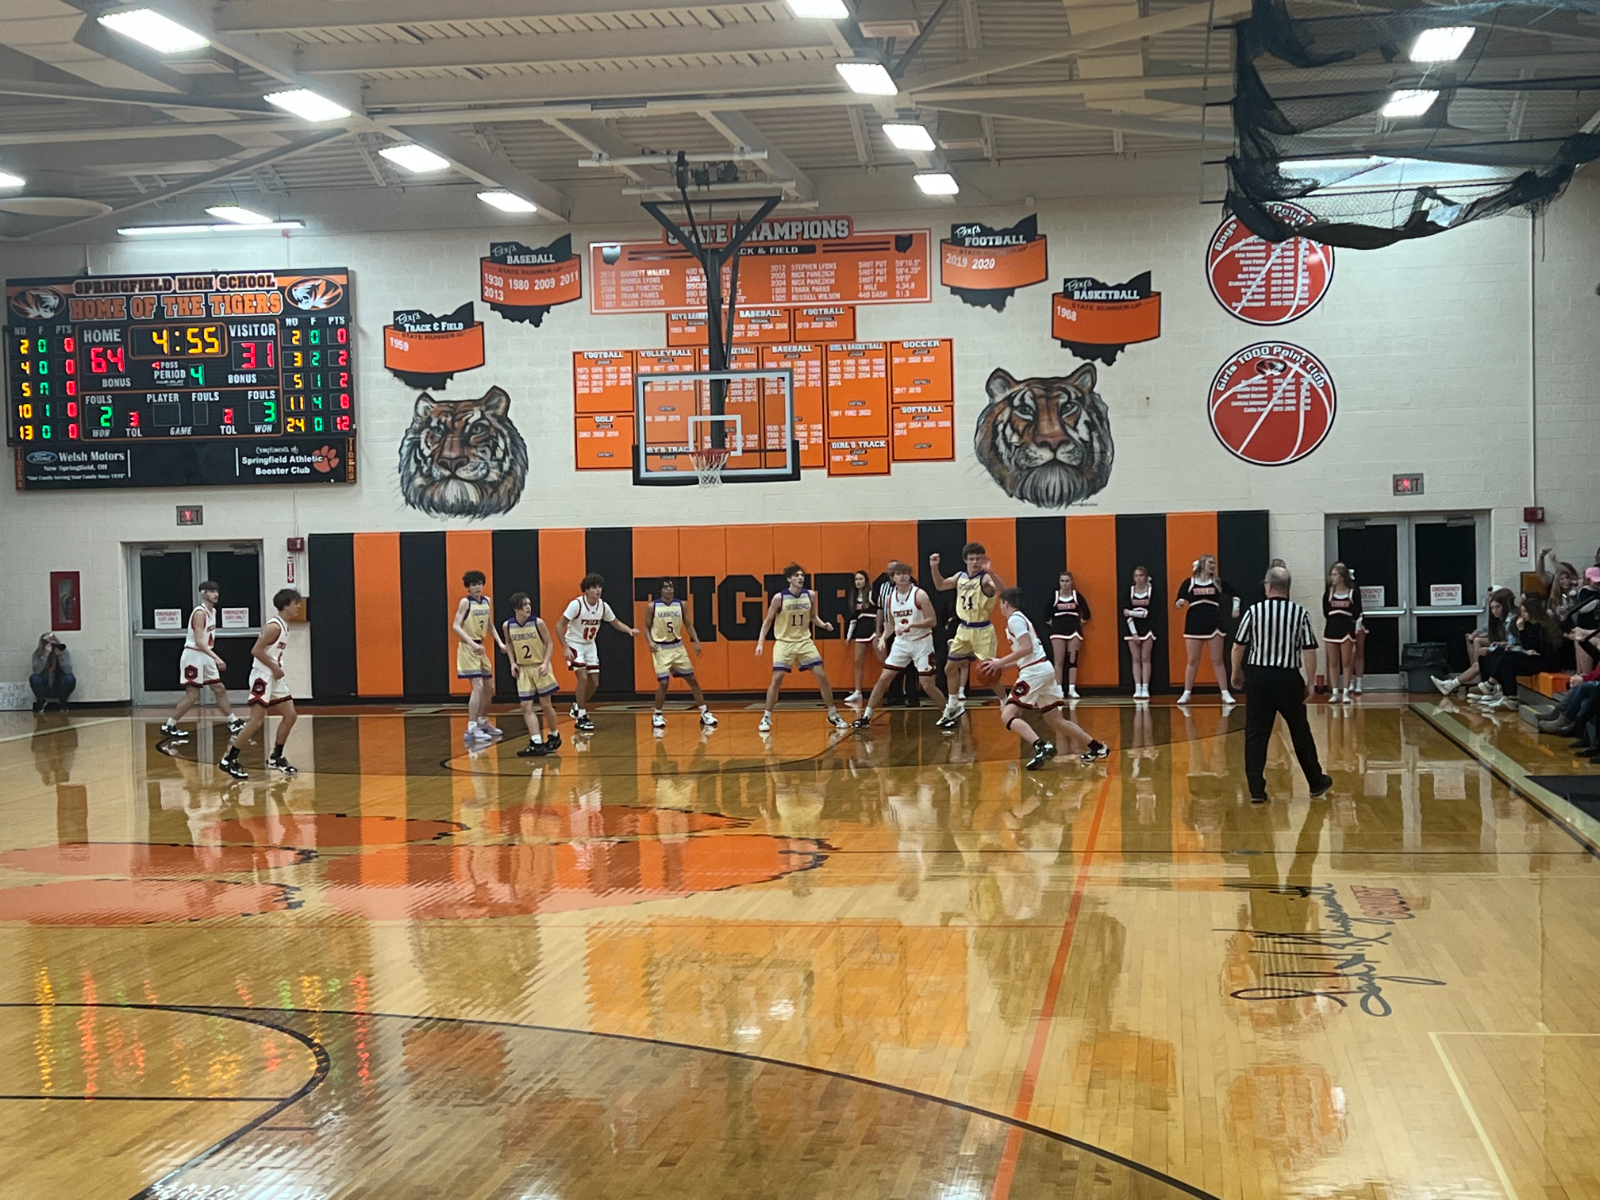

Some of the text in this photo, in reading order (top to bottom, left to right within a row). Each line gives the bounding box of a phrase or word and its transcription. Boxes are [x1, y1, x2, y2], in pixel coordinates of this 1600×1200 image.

[964, 235, 1027, 247] FOOTBALL
[1214, 222, 1237, 251] Boys
[757, 247, 766, 255] &
[770, 247, 799, 255] FIELD
[506, 254, 555, 265] BASEBALL
[945, 253, 996, 270] 2019 2020
[498, 267, 519, 275] STATE
[74, 273, 277, 295] SPRINGFIELD HIGH SCHOOL
[484, 270, 579, 290] 1930 1980 2009 2011
[484, 286, 504, 301] 2013
[1073, 290, 1140, 300] BASKETBALL
[70, 292, 282, 320] HOME OF THE TIGERS
[1072, 302, 1095, 311] STATE
[739, 310, 782, 318] BASEBALL
[1057, 305, 1077, 322] 1968
[286, 317, 345, 326] NO F PTS
[404, 322, 431, 332] TRACK
[441, 322, 464, 331] FIELD
[14, 325, 72, 336] NO F PTS
[83, 329, 122, 343] HOME
[229, 323, 277, 337] VISITOR
[401, 332, 423, 341] STATE
[152, 327, 220, 354] 4:55
[292, 329, 301, 345] 2
[310, 329, 319, 344] 0
[20, 339, 29, 354] 2
[38, 339, 47, 353] 0
[903, 340, 940, 348] SOCCER
[241, 343, 273, 369] 31
[293, 352, 303, 367] 3
[311, 351, 320, 366] 2
[584, 351, 624, 359] FOOTBALL
[640, 349, 692, 357] VOLLEYBALL
[90, 347, 125, 373] 64
[160, 361, 178, 369] POSS
[21, 361, 30, 375] 4
[39, 360, 48, 375] 0
[1216, 346, 1327, 391] Girls 1000 Point Club
[153, 369, 186, 380] PERIOD
[190, 365, 204, 385] 4
[228, 374, 257, 384] BONUS
[293, 374, 303, 389] 5
[21, 382, 31, 397] 5
[102, 378, 131, 388] BONUS
[85, 395, 112, 405] FOULS
[146, 391, 220, 403] PLAYER FOULS
[248, 390, 276, 400] FOULS
[290, 396, 322, 410] 11 4
[19, 403, 32, 419] 10
[100, 406, 113, 427] 2
[223, 408, 233, 424] 2
[263, 401, 276, 422] 3
[902, 406, 943, 414] SOFTBALL
[129, 410, 140, 427] 3
[286, 415, 350, 432] 24 0 12
[594, 415, 615, 423] GOLF
[20, 425, 33, 440] 13
[42, 425, 51, 439] 0
[92, 429, 110, 438] WON
[125, 427, 143, 437] TOL
[170, 426, 192, 436] GAME
[220, 425, 237, 435] TOL
[254, 424, 273, 433] WON
[858, 440, 886, 448] TRACK
[58, 451, 88, 462] Welsh
[90, 451, 125, 461] Motors
[242, 454, 324, 465] Springfield Athletic
[255, 466, 310, 475] Booster Club
[1395, 477, 1420, 493] EXIT
[666, 621, 674, 633] 5
[791, 614, 804, 627] 11
[583, 626, 597, 640] 13
[521, 645, 532, 659] 2
[1350, 885, 1416, 920] COURT
